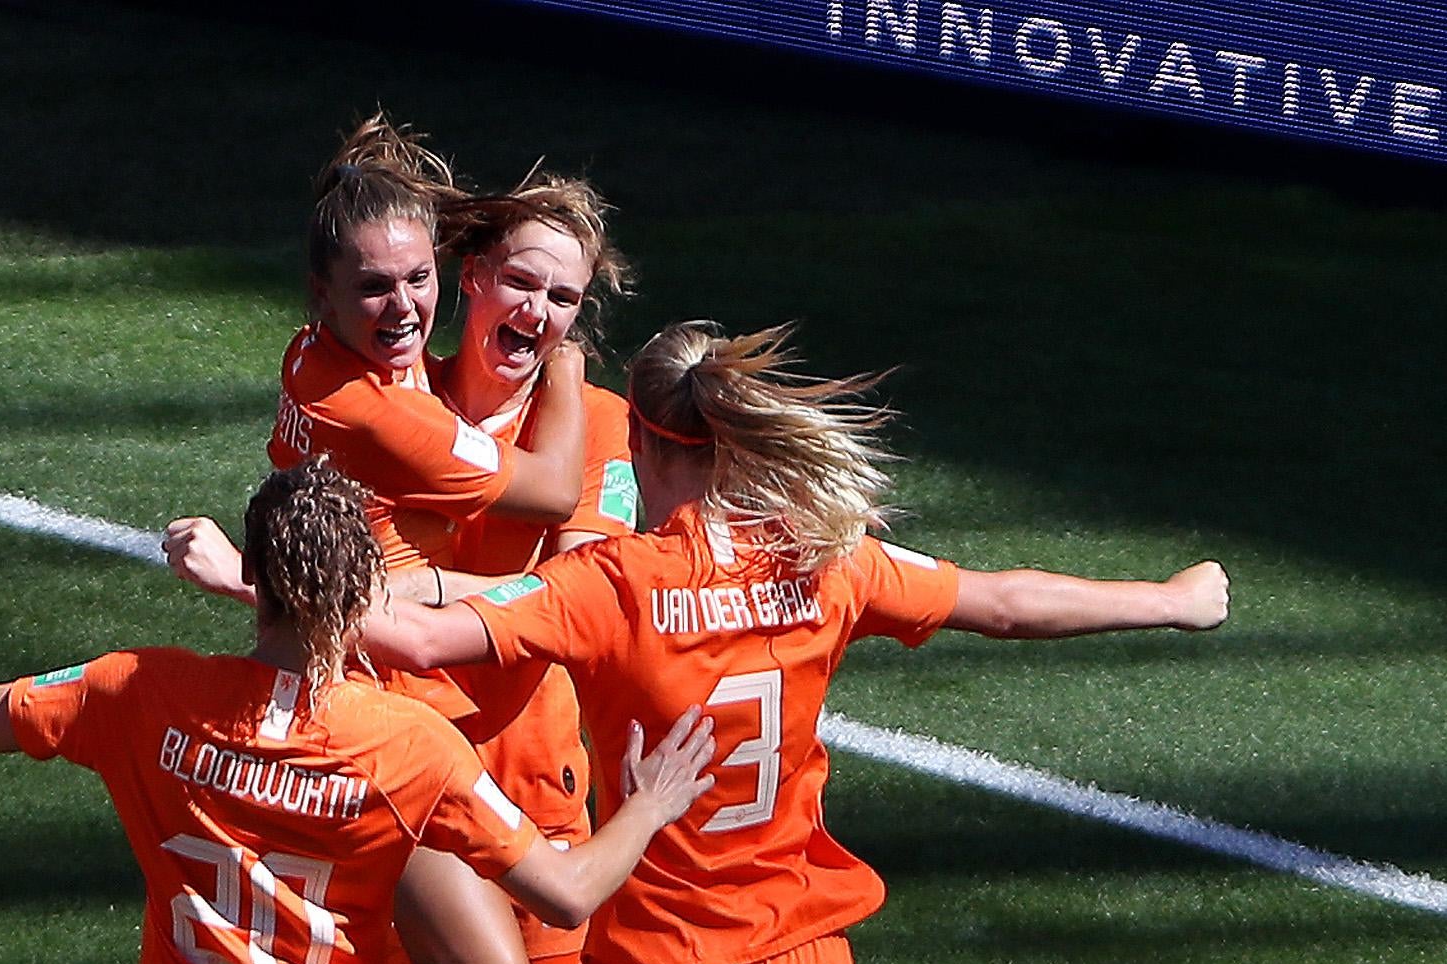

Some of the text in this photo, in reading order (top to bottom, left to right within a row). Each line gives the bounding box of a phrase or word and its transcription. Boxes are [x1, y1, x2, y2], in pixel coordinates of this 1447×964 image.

[827, 0, 1442, 140] INNOVATIVE
[651, 588, 699, 634] VAN
[698, 587, 753, 630] DER
[159, 726, 368, 819] BLOODWORTH
[700, 669, 782, 833] 3
